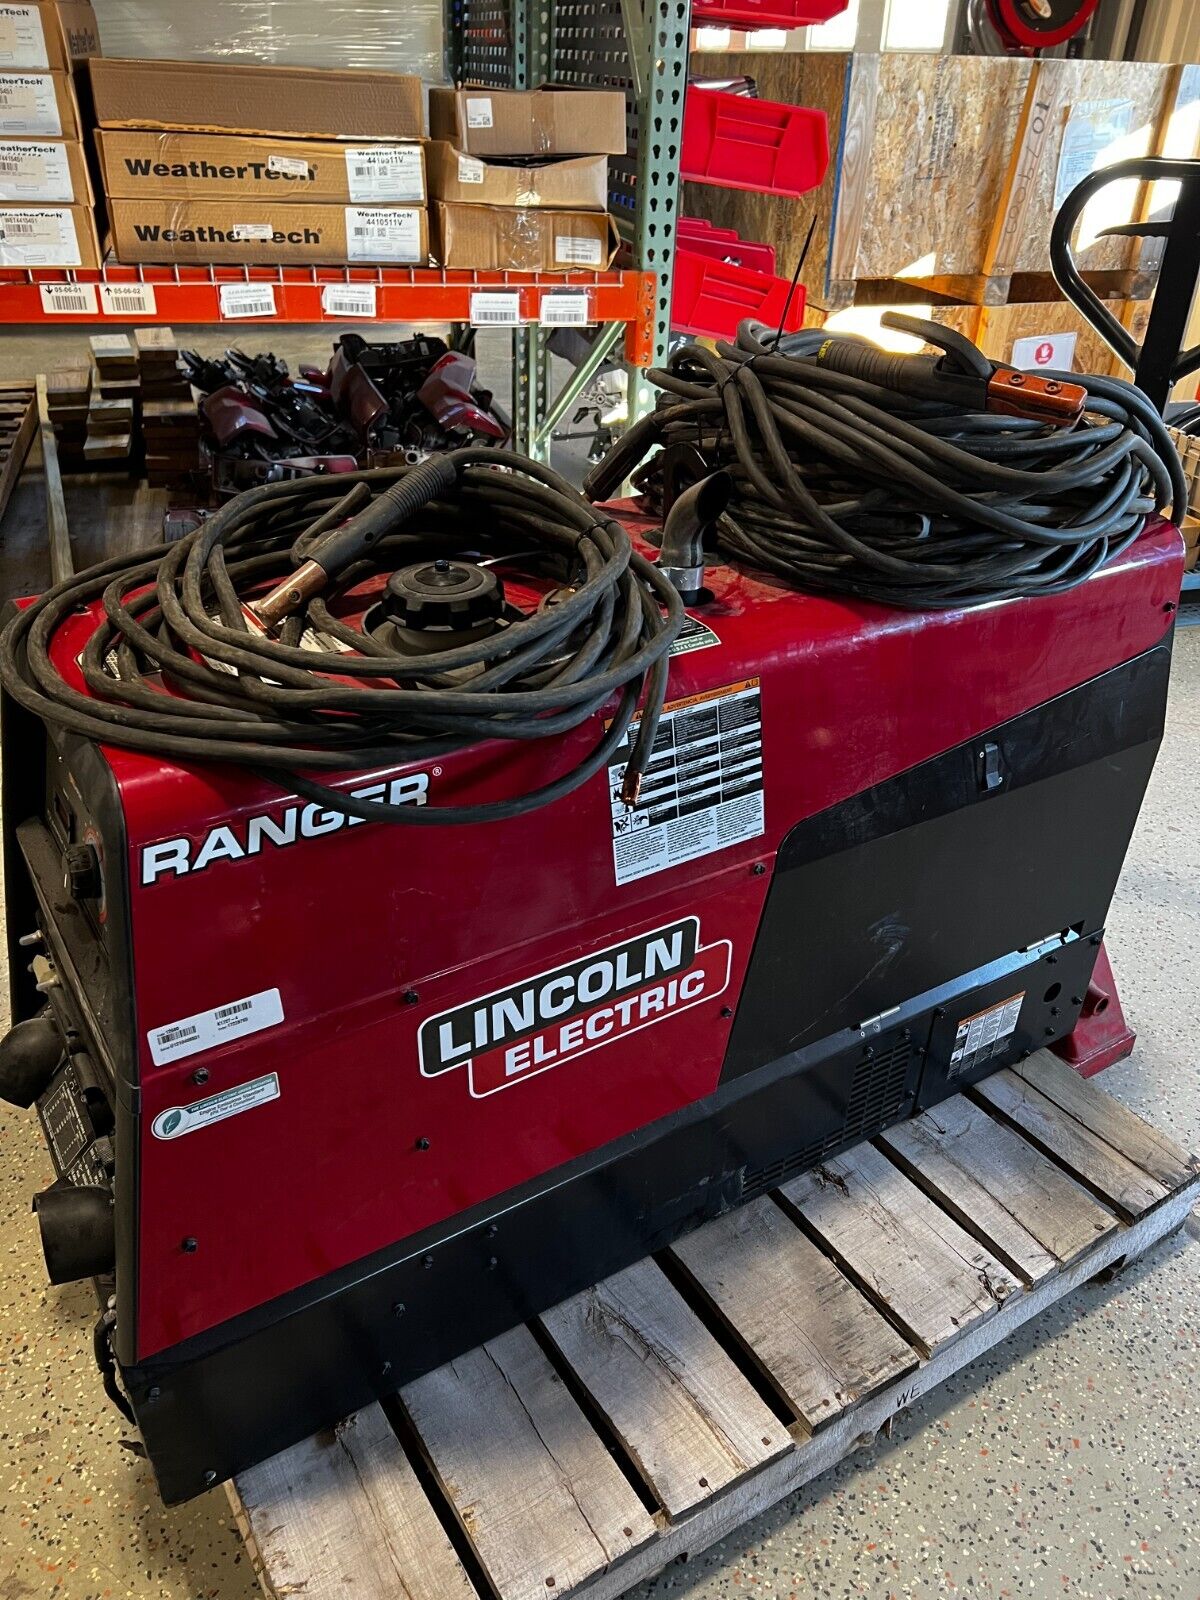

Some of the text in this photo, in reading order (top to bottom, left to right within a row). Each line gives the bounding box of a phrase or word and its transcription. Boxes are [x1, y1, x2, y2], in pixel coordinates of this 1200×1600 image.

[134, 225, 320, 244] Weatheech
[439, 930, 683, 1062] LINCOLN
[505, 969, 705, 1076] ELECTRIC
[896, 1380, 923, 1407] WE
